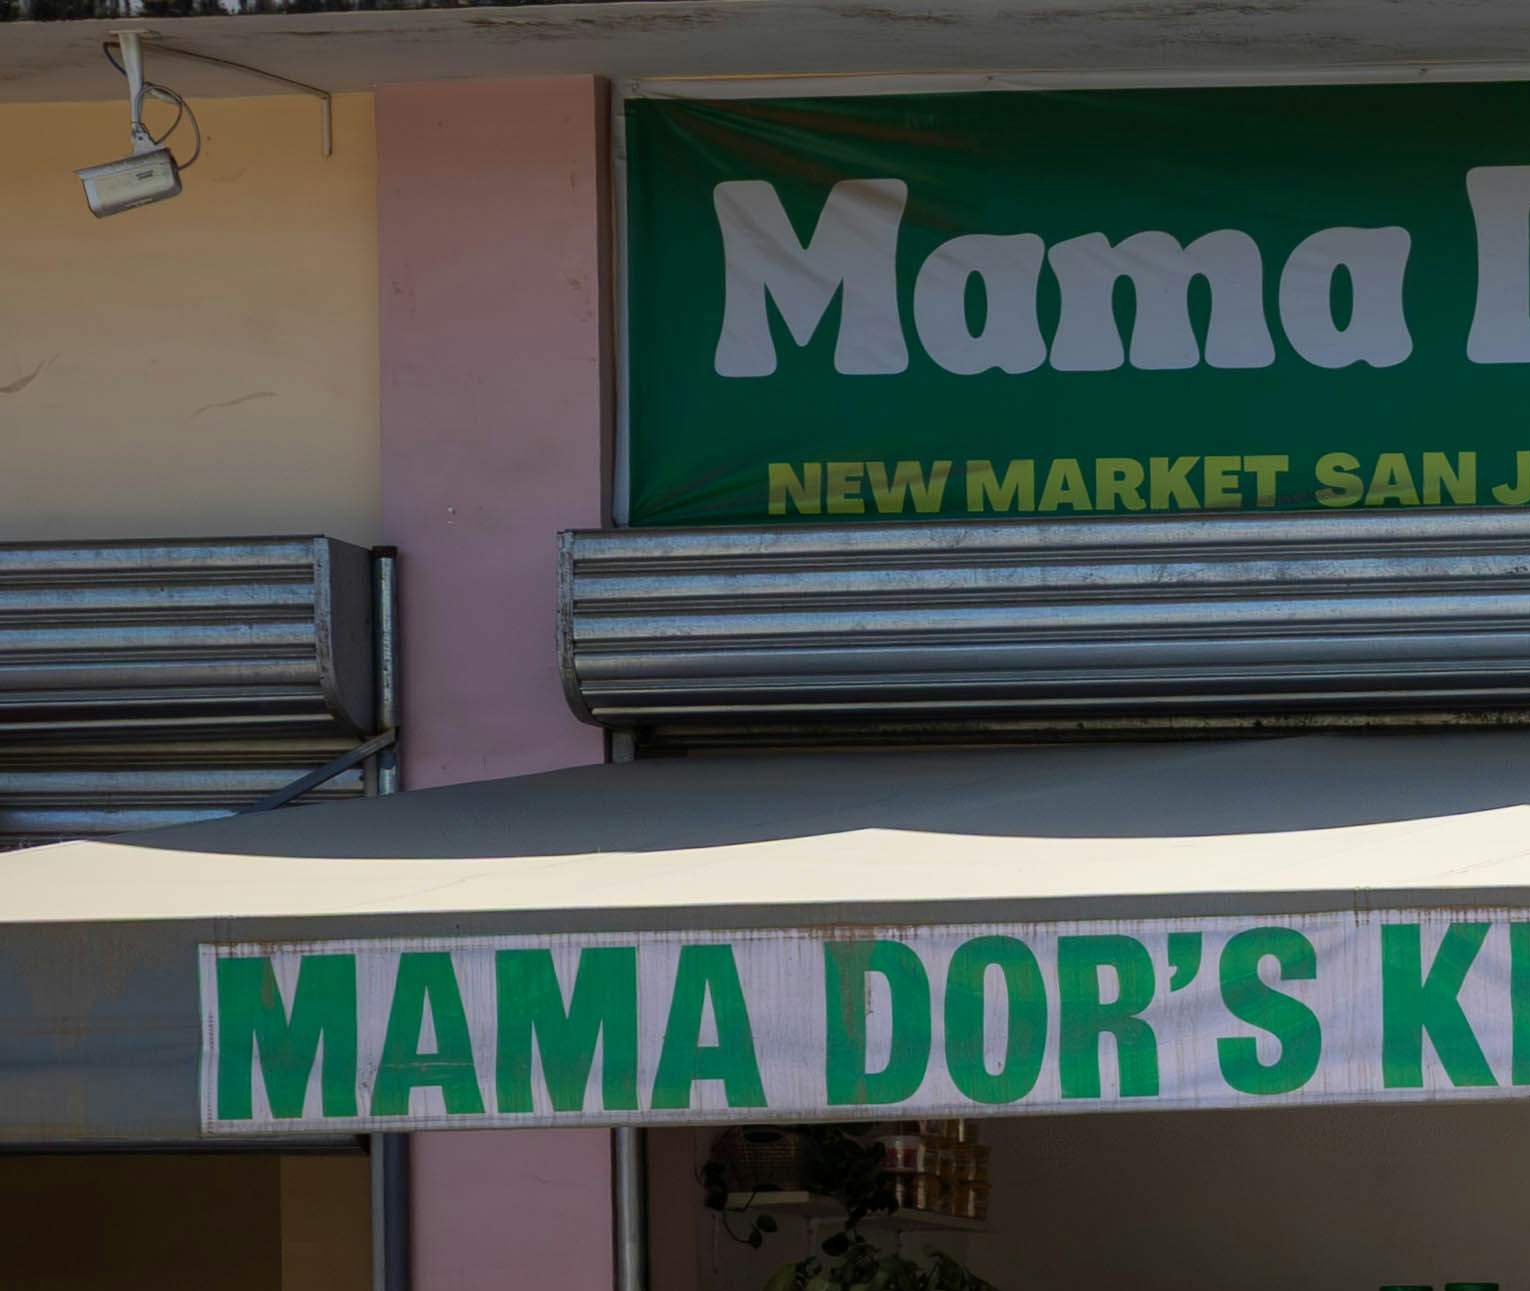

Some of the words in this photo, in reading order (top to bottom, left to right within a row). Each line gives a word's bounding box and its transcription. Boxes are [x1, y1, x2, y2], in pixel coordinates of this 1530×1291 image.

[713, 179, 1412, 378] Mama
[767, 461, 950, 515] NEW
[966, 453, 1289, 512] MARKET
[1314, 449, 1479, 508] SAN
[217, 942, 767, 1121] MAMA
[824, 926, 1322, 1106] DOR'S
